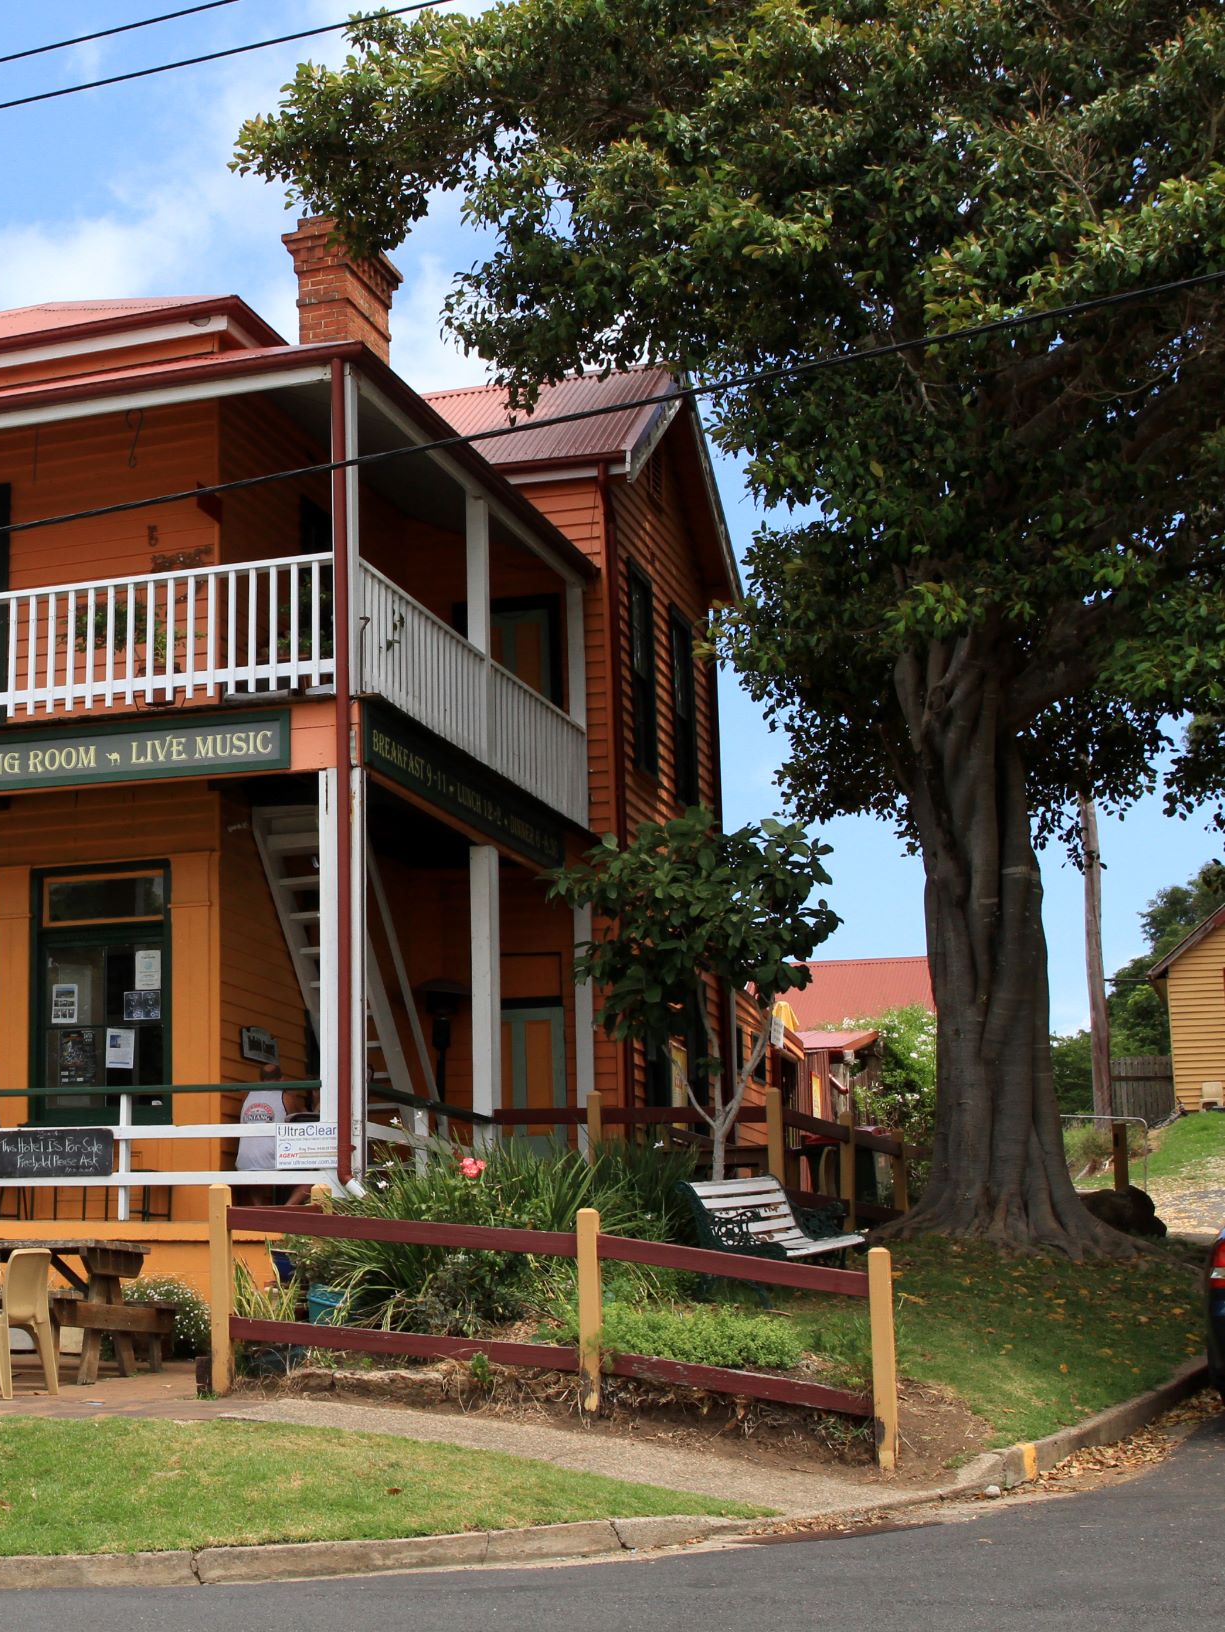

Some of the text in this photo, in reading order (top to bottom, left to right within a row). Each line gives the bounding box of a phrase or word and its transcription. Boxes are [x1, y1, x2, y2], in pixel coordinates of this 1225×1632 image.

[28, 746, 97, 773] ROOM
[130, 734, 187, 765] LIVE
[194, 730, 274, 760] MUSIC
[372, 729, 425, 781] BREAKFAST
[278, 1125, 337, 1138] UltraClear
[17, 1137, 43, 1153] Hotel
[65, 1137, 81, 1153] For
[81, 1137, 103, 1154] Sale
[79, 1153, 101, 1169] Ask
